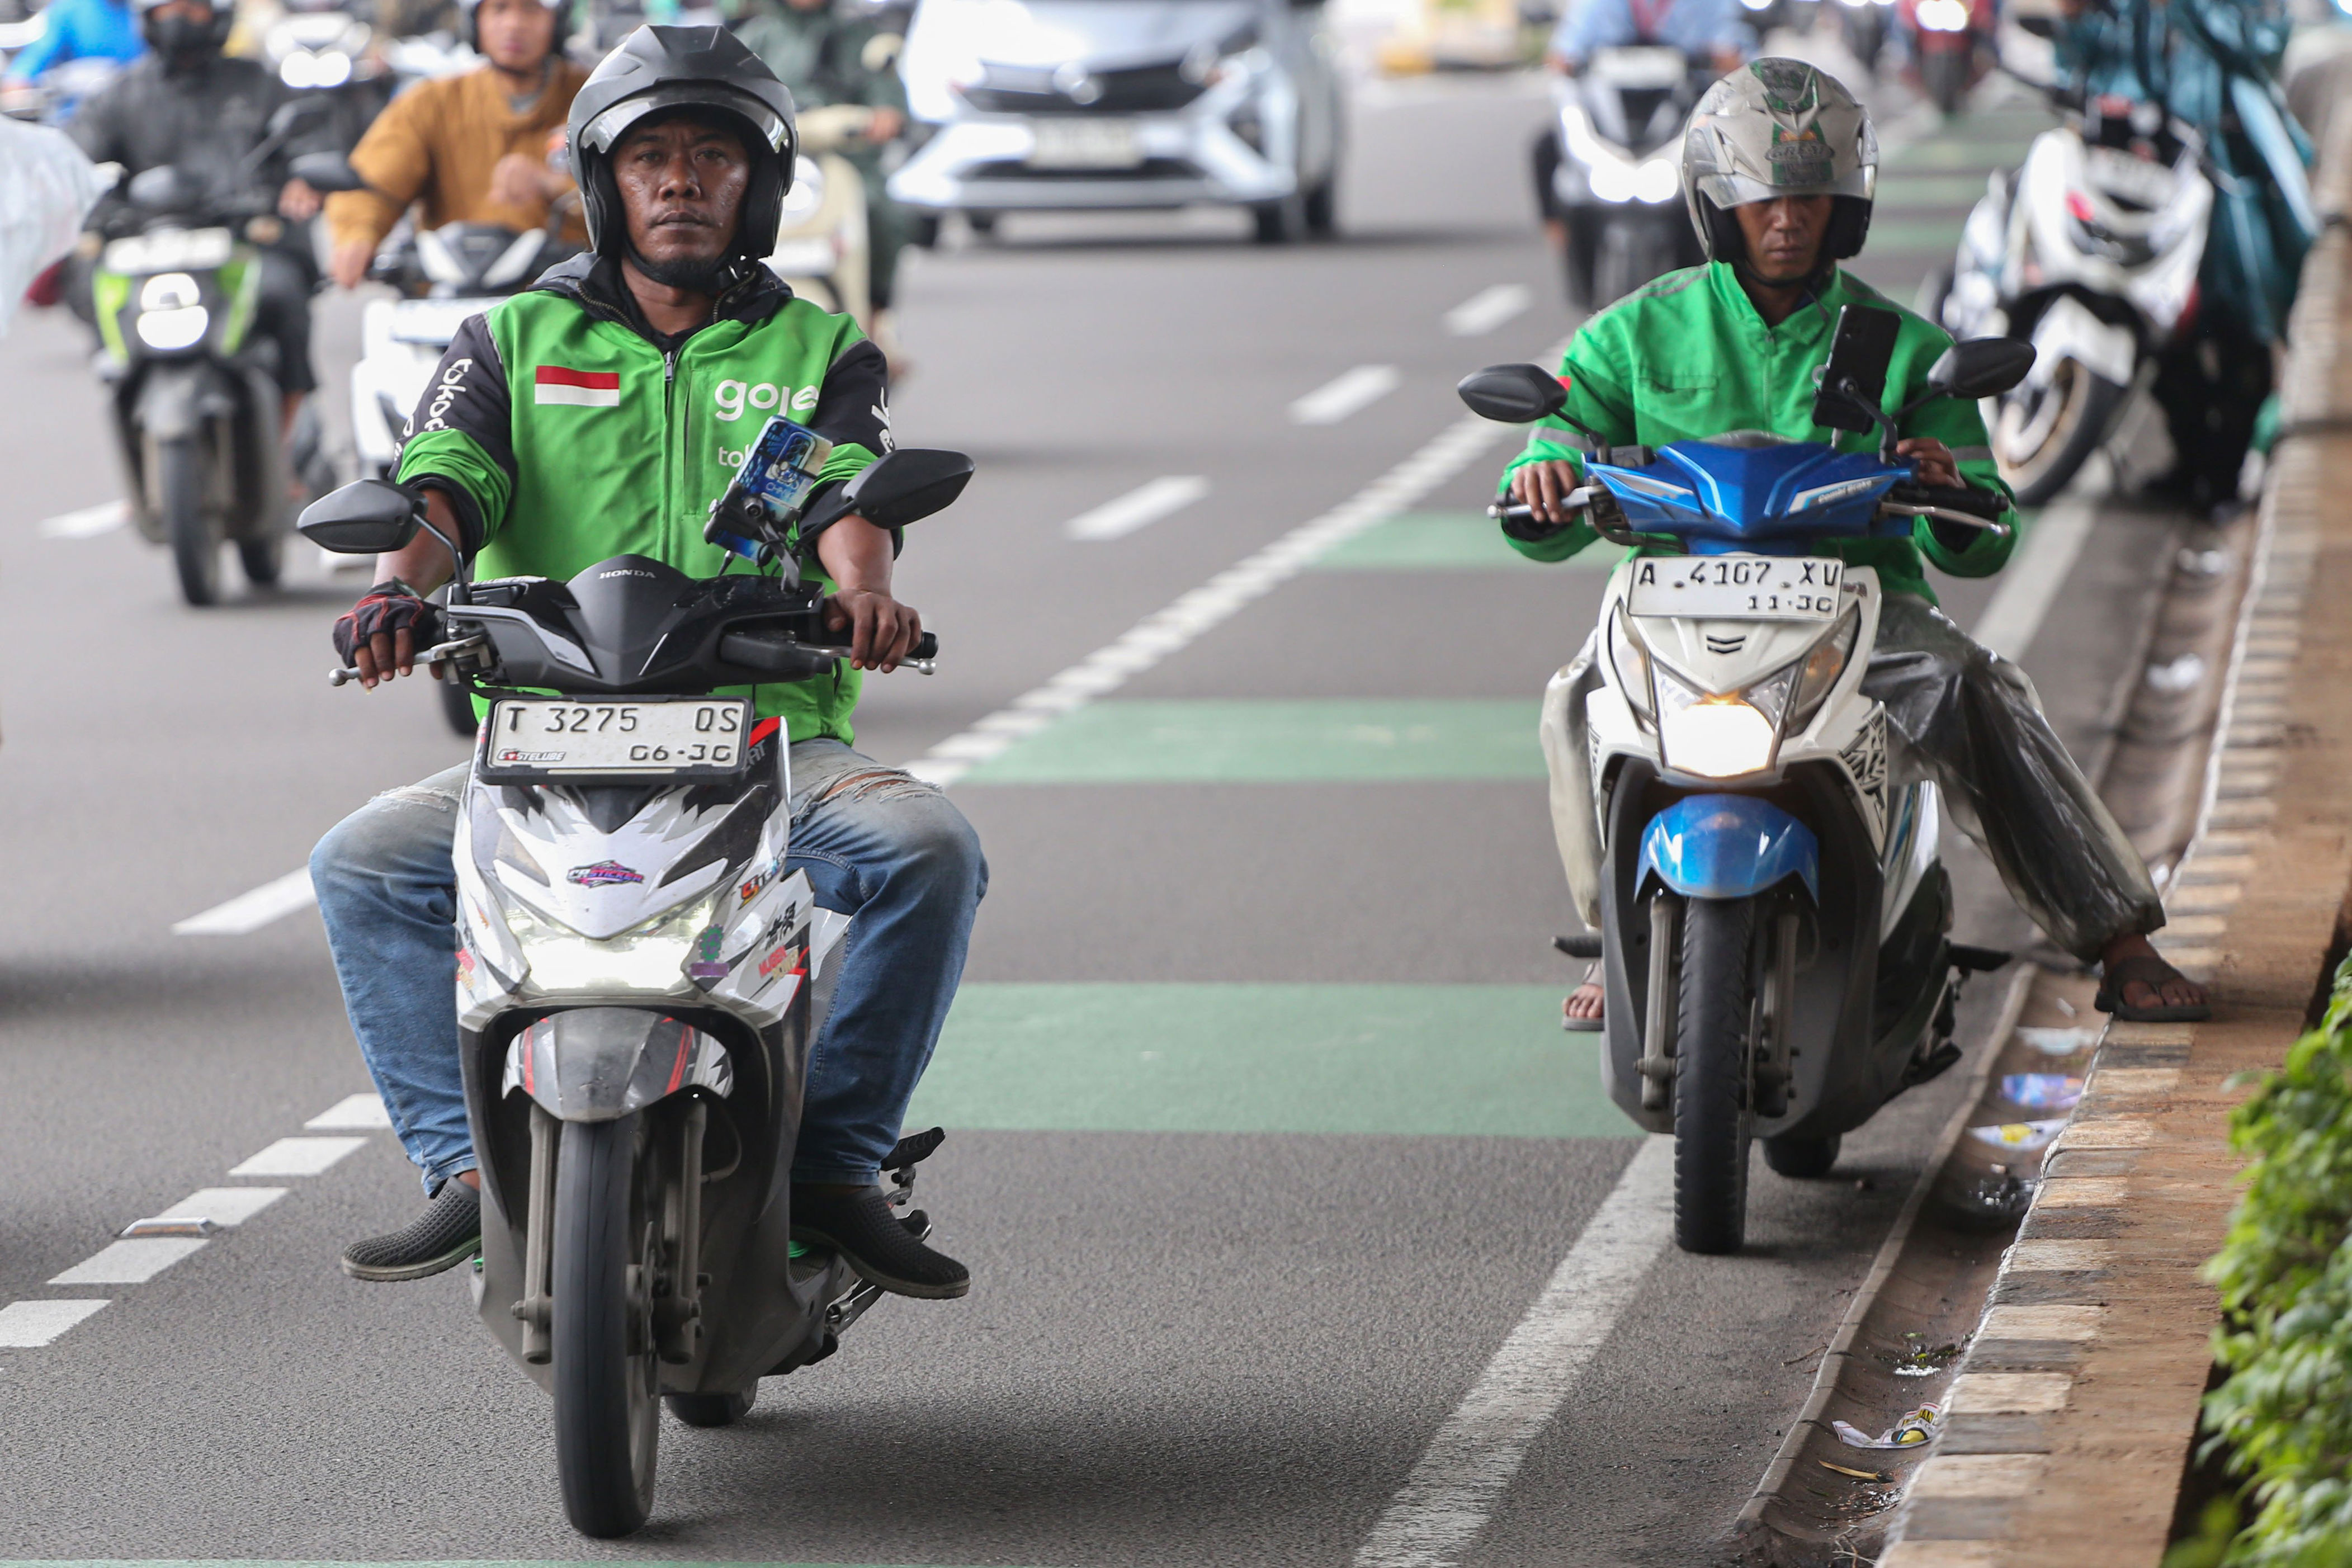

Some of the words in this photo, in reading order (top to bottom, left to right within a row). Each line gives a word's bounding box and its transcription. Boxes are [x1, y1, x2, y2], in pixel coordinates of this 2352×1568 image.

[598, 569, 657, 579] HONDA
[1638, 561, 1655, 585] A
[1690, 560, 1771, 584] 4107
[507, 707, 527, 732] T
[545, 707, 639, 732] 3275
[695, 707, 739, 732] QS
